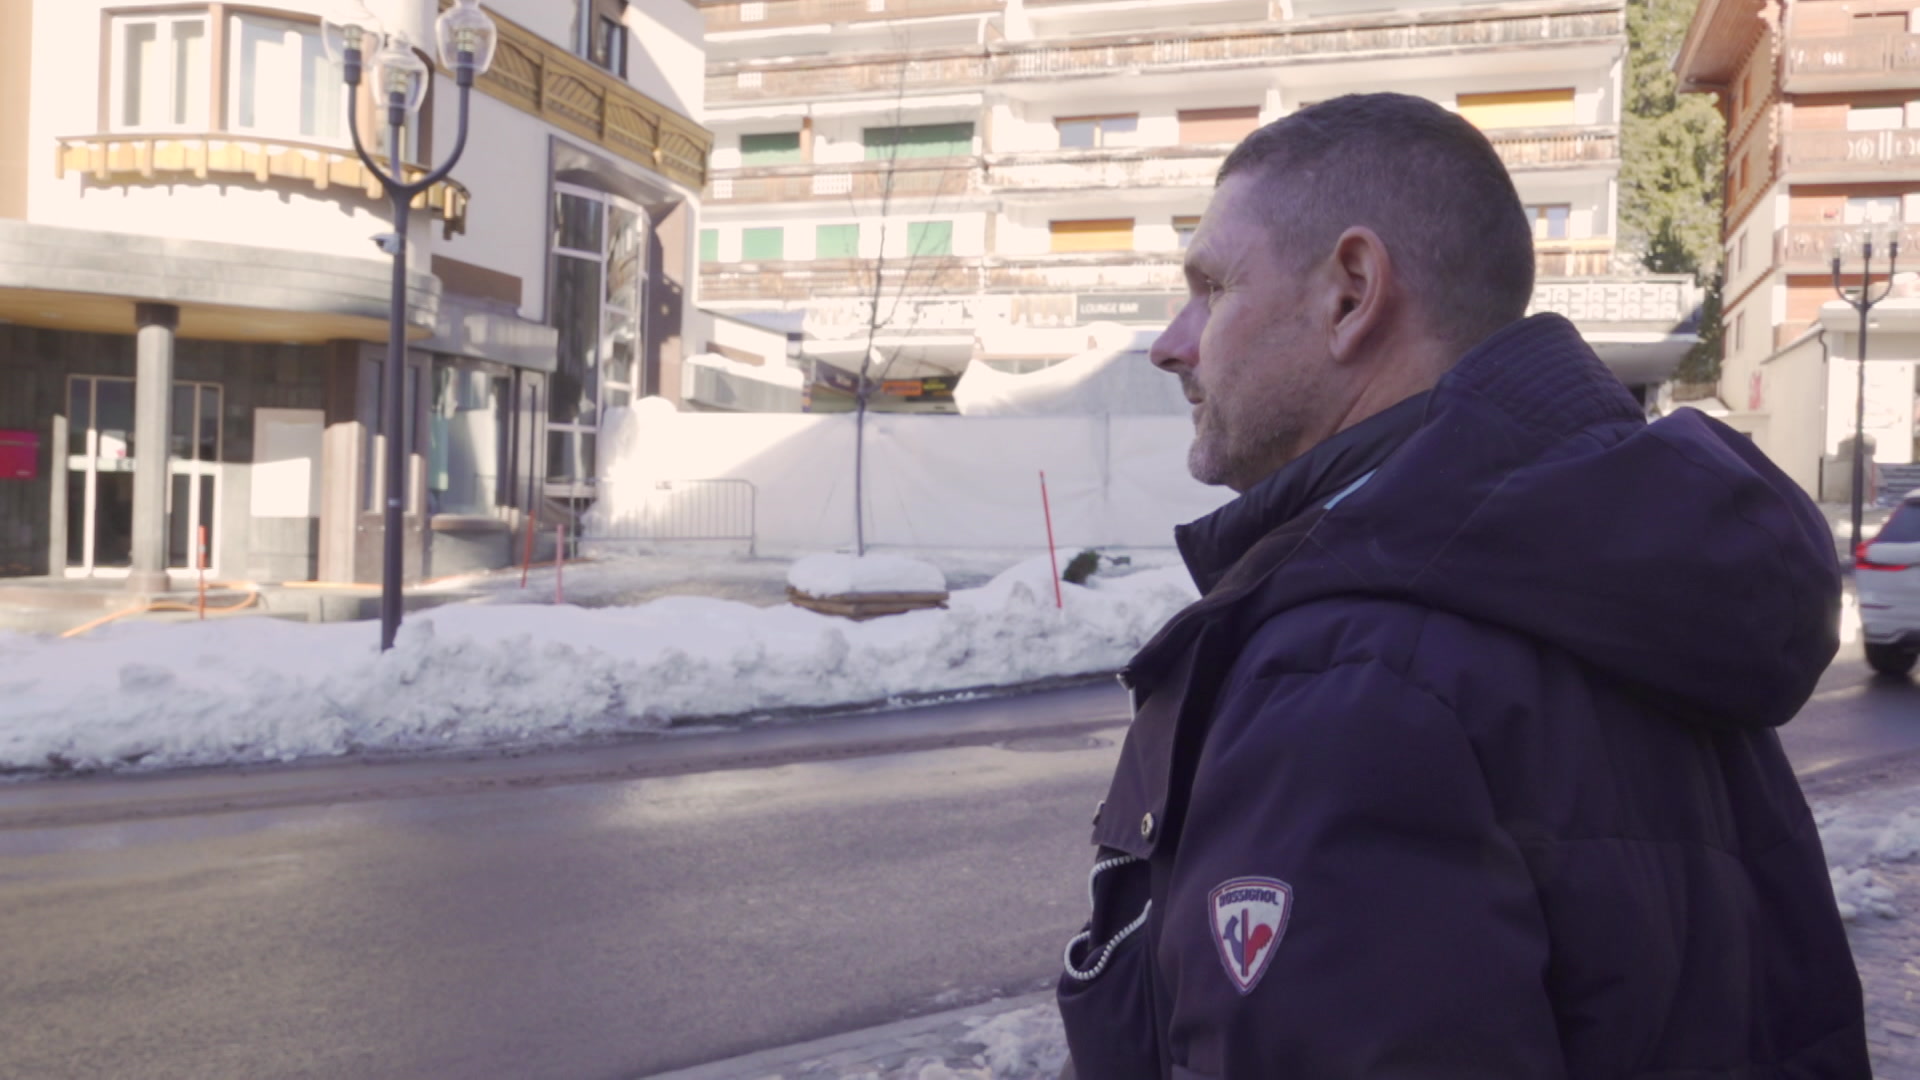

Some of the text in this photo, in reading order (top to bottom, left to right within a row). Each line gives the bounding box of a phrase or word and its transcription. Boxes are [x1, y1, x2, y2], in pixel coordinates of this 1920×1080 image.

[1080, 302, 1139, 314] LOUNGE BAR
[1219, 888, 1279, 907] ROSSIGNOL
